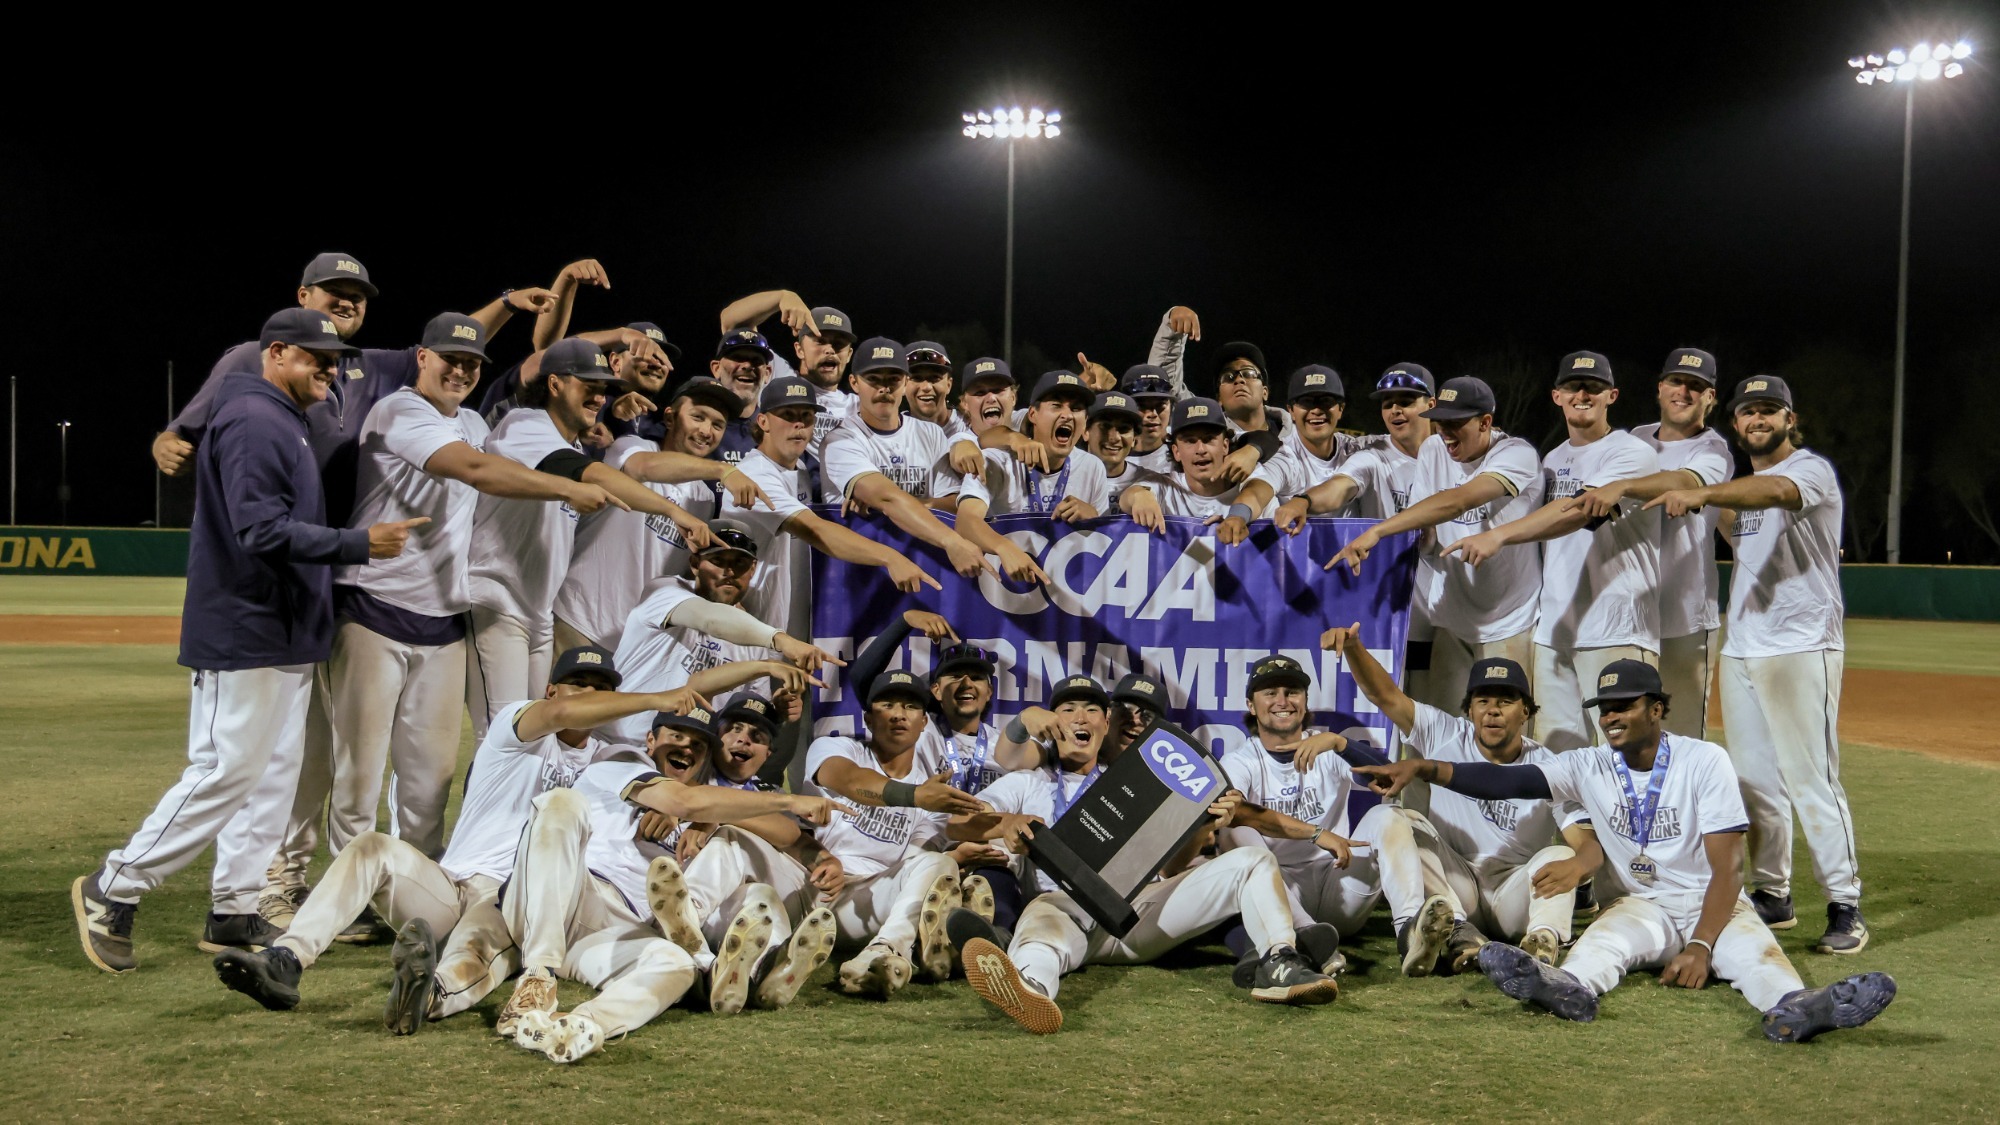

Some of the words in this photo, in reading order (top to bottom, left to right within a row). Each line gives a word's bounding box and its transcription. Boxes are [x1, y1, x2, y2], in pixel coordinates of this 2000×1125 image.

[336, 260, 360, 275] MB
[823, 314, 843, 327] MB
[452, 325, 477, 341] MB
[872, 347, 894, 360] MB
[975, 361, 996, 374] MB
[1572, 357, 1595, 369] MB
[1678, 354, 1703, 368] MB
[1056, 374, 1079, 386] MB
[1304, 373, 1326, 387] MB
[786, 384, 808, 397] MB
[1744, 381, 1768, 393] MB
[1105, 396, 1126, 407] MB
[1186, 405, 1208, 418] MB
[978, 529, 1216, 622] CCAA
[577, 651, 602, 665] MB
[889, 673, 913, 684] MB
[1485, 666, 1508, 679] MB
[1068, 678, 1092, 688] MB
[1131, 680, 1156, 695] MB
[746, 699, 767, 715] MB
[1151, 740, 1212, 797] CCAA
[1121, 785, 1135, 798] 2024
[1100, 795, 1125, 820] BASEBALL
[1079, 817, 1106, 842] CHAMPION
[1080, 808, 1115, 840] TOURNAMENT
[1630, 862, 1652, 873] CCAA
